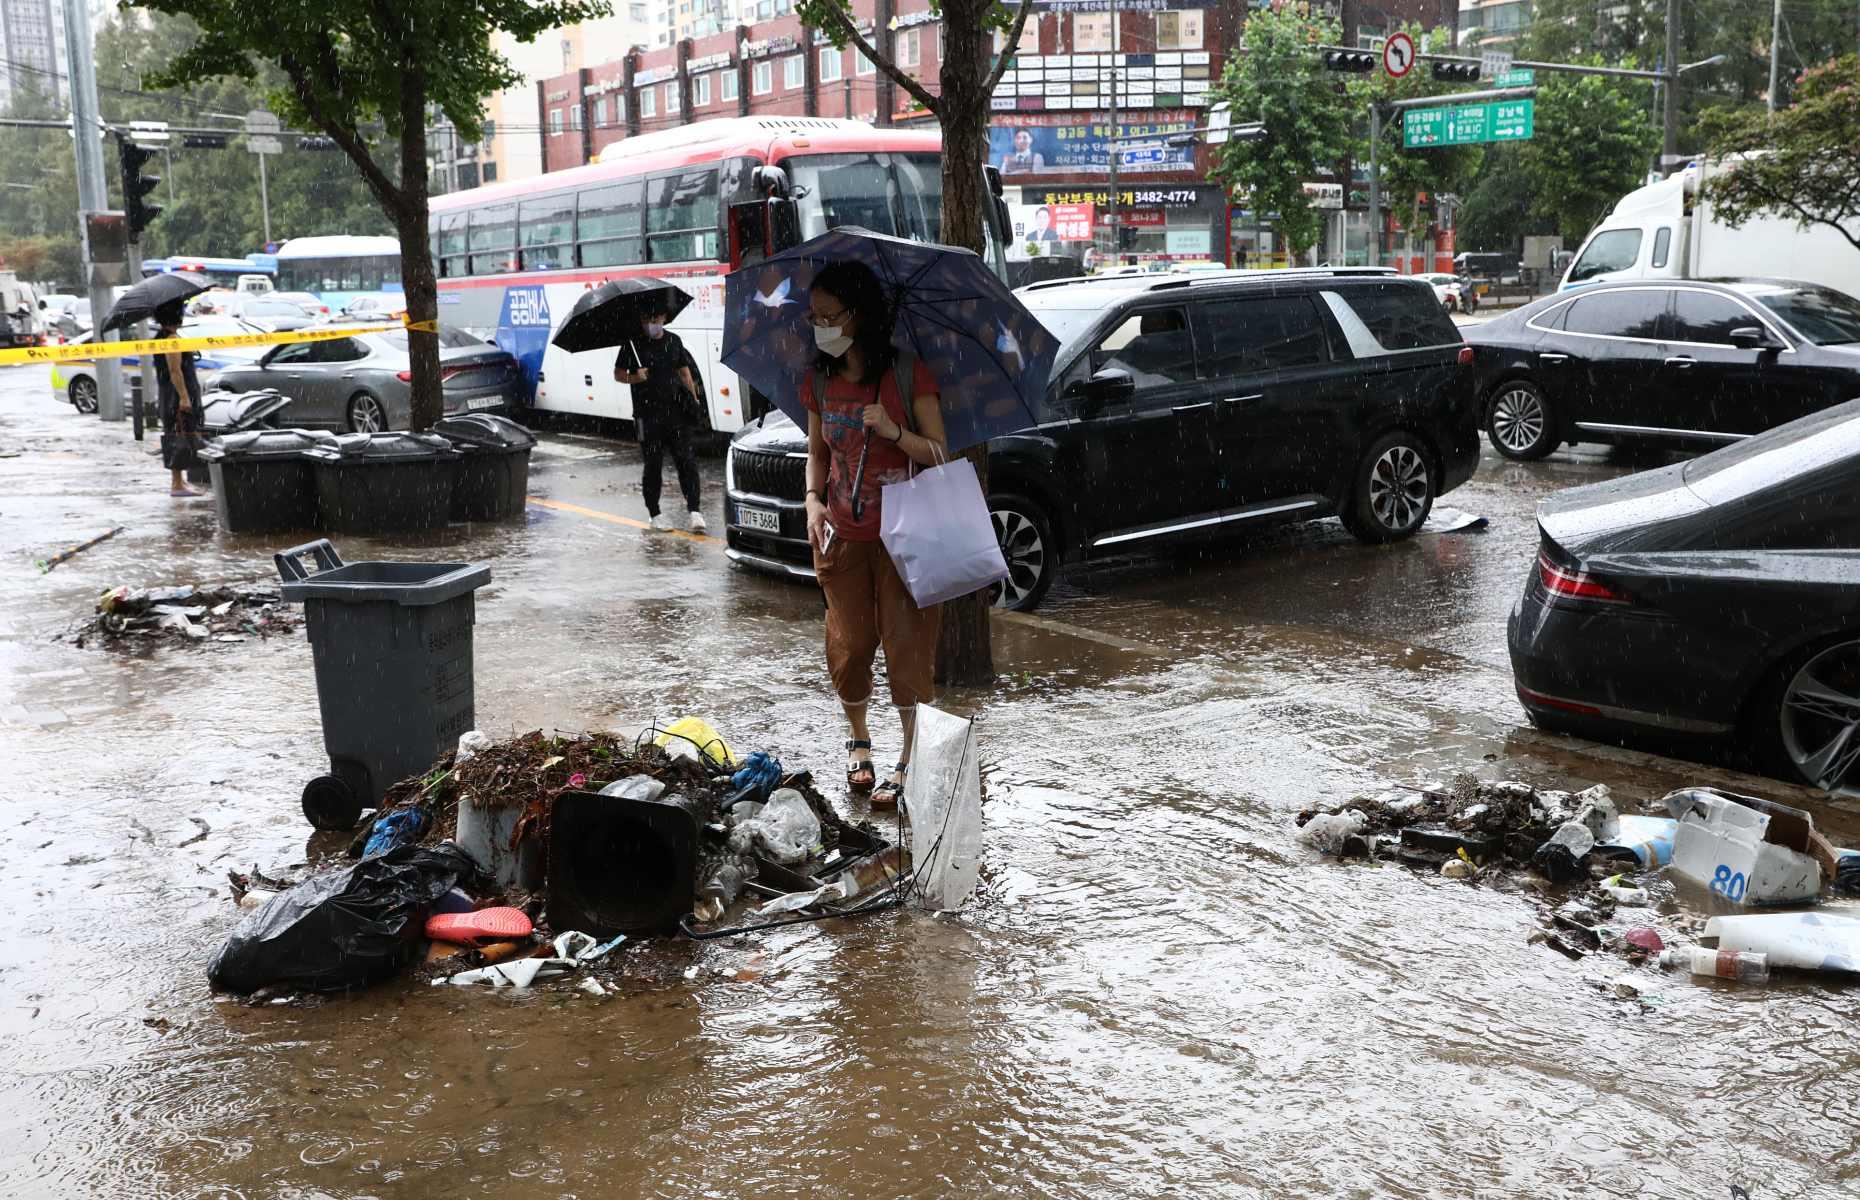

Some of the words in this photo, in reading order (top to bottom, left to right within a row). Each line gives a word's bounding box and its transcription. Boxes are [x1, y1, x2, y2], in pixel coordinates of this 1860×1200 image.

[1498, 106, 1525, 118] 강남역
[1044, 191, 1134, 207] 동남부동산개
[1135, 191, 1196, 203] 3482-4774
[509, 288, 550, 326] 공공버스
[759, 512, 778, 531] 3684
[1709, 864, 1745, 902] 80
